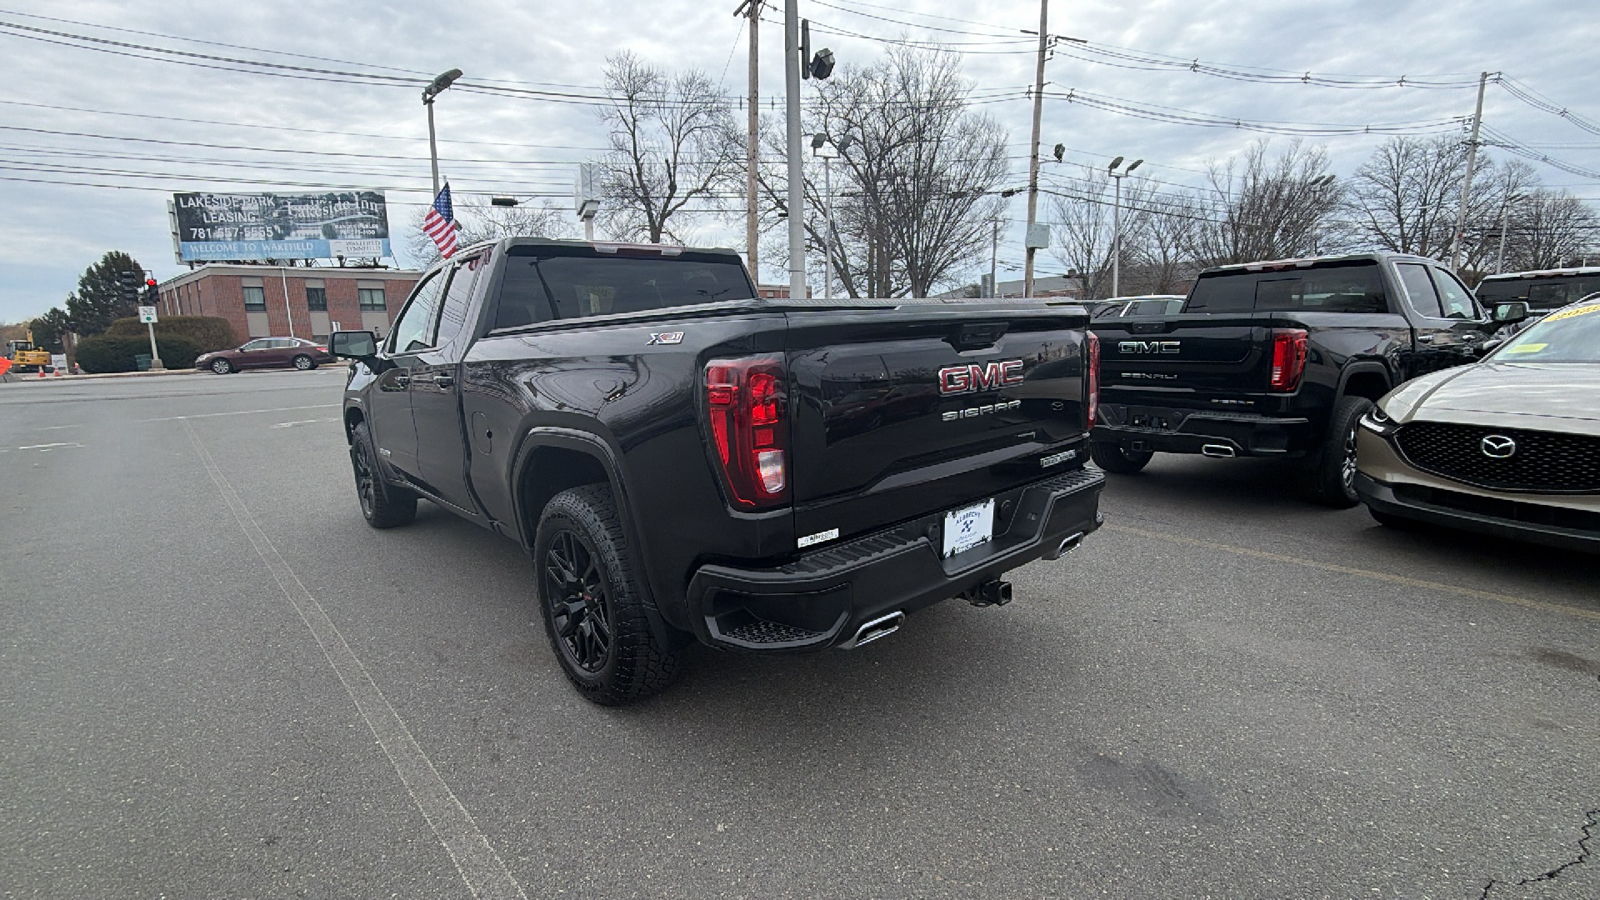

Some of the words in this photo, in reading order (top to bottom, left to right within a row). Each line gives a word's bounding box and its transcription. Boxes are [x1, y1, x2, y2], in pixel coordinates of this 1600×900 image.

[180, 196, 240, 208] LAKESIDE
[243, 196, 275, 207] PARK
[286, 196, 350, 217] Lakeside
[355, 192, 379, 213] Inn
[203, 211, 256, 223] LEASING
[190, 243, 237, 253] WELCOME
[244, 243, 256, 251] TO
[262, 241, 314, 252] WAKEFIELD
[1118, 341, 1181, 354] GMC
[938, 359, 1024, 397] GMC
[1121, 372, 1178, 380] DENALI
[941, 399, 1022, 421] SIERRA
